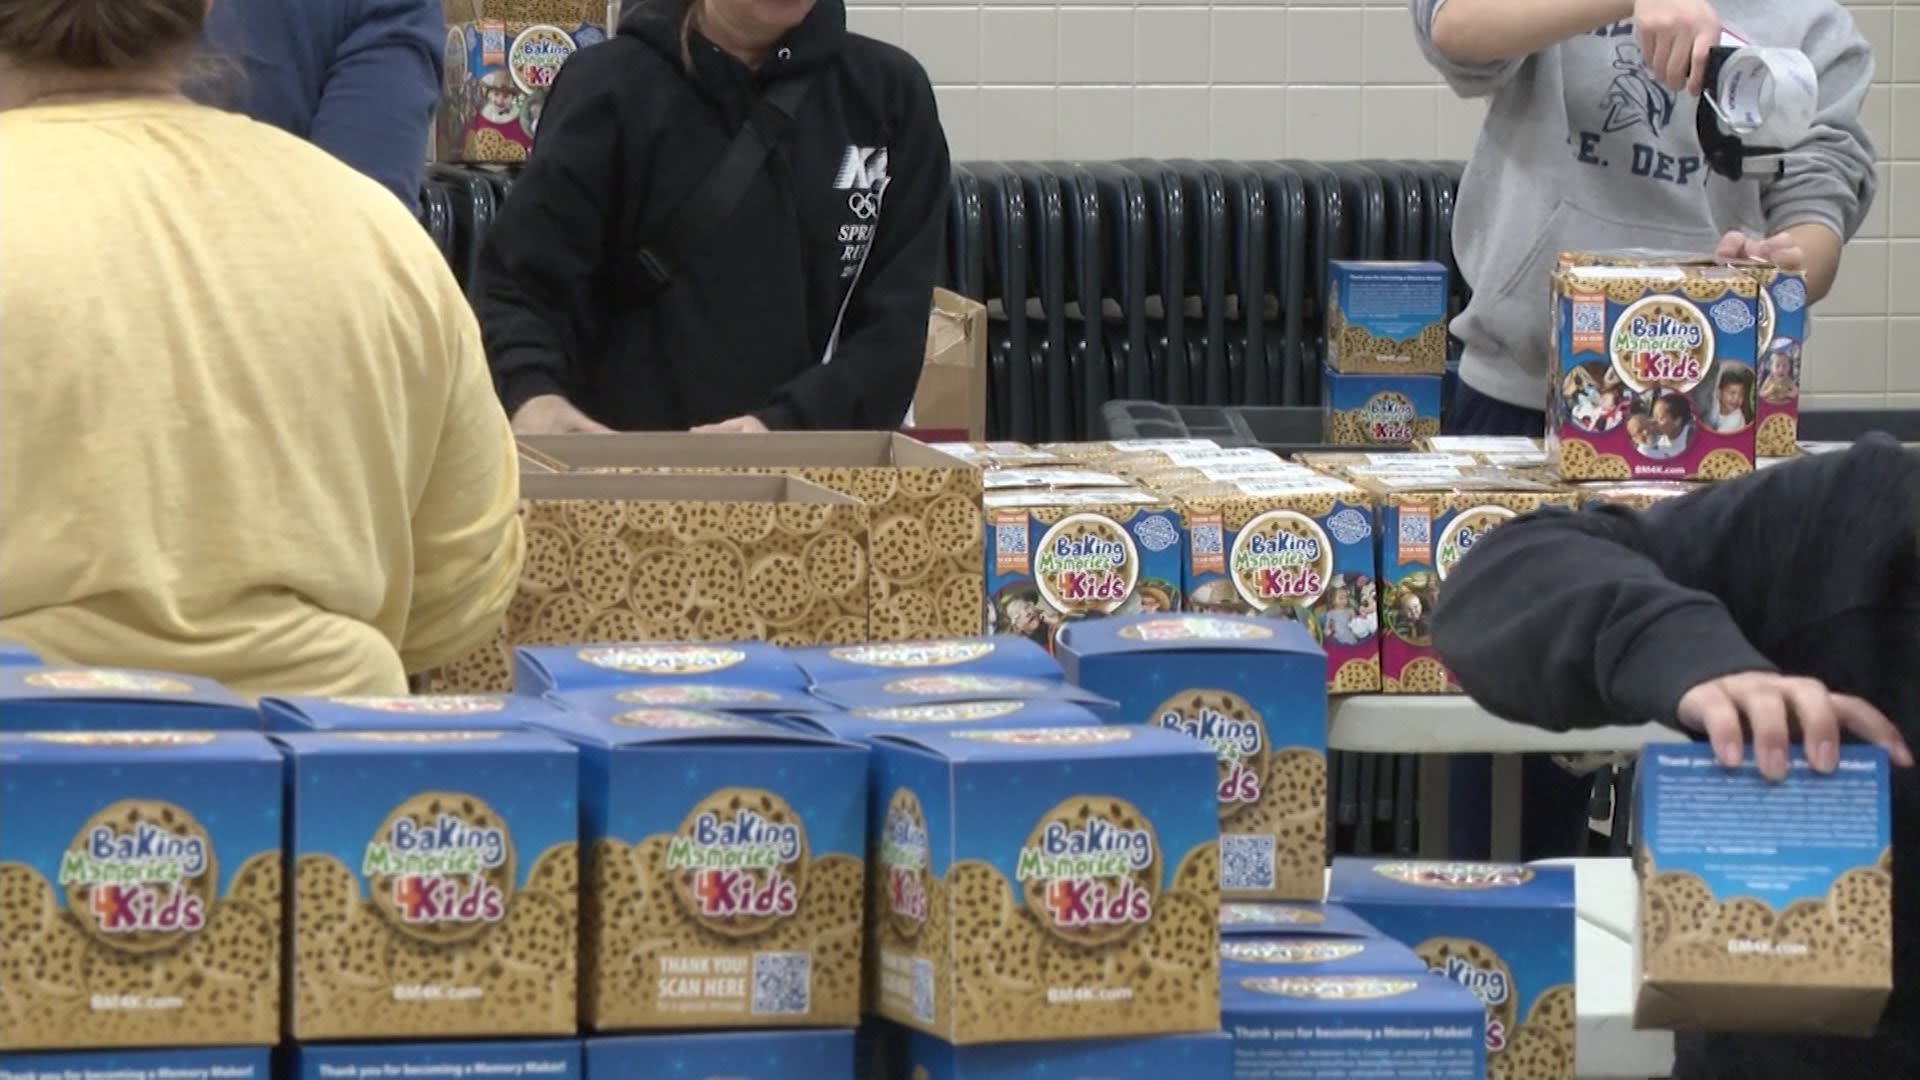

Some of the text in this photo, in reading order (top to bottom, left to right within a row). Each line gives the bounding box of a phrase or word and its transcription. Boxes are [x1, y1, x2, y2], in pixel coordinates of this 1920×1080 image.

[1630, 143, 1706, 185] DEP
[659, 957, 709, 974] THANK
[658, 977, 746, 997] SCAN HERE
